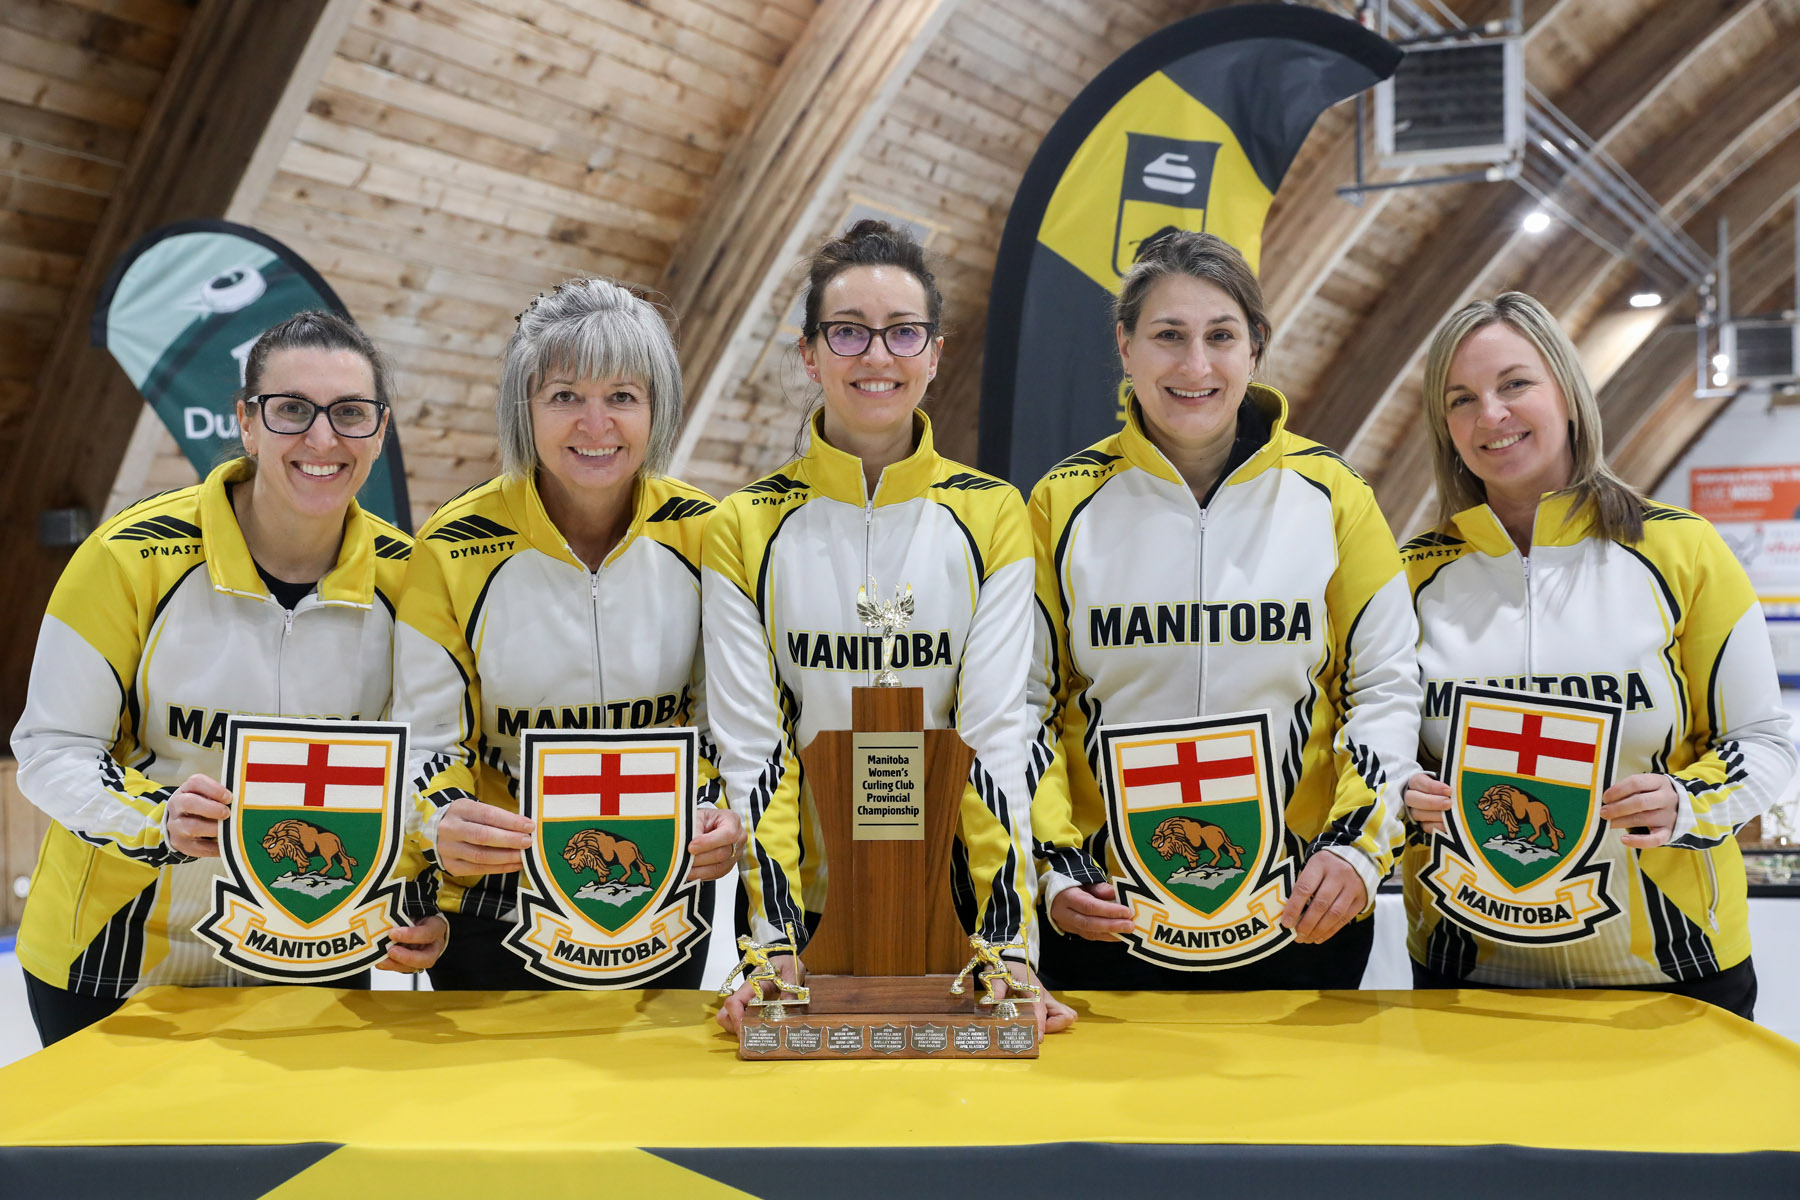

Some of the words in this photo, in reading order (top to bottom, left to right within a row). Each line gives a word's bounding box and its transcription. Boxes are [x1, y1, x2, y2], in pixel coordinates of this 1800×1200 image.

[184, 407, 240, 439] Du
[1049, 464, 1116, 480] DYNASTY
[752, 492, 808, 506] DYNASTY
[140, 544, 204, 559] DYNAST
[450, 541, 515, 559] DYNASTY
[1090, 601, 1313, 648] MANITOBA
[786, 630, 954, 671] MANITOBA
[867, 755, 910, 765] Manitoba
[868, 768, 909, 777] Women's
[862, 780, 894, 792] Curling
[895, 780, 915, 790] Club
[866, 793, 911, 803] Provincial
[857, 805, 920, 818] Championship
[1456, 884, 1573, 925] MANITOBA
[1153, 916, 1269, 949] MANITOBA
[245, 929, 367, 959] MANITOBA
[553, 936, 668, 967] MANITOBA
